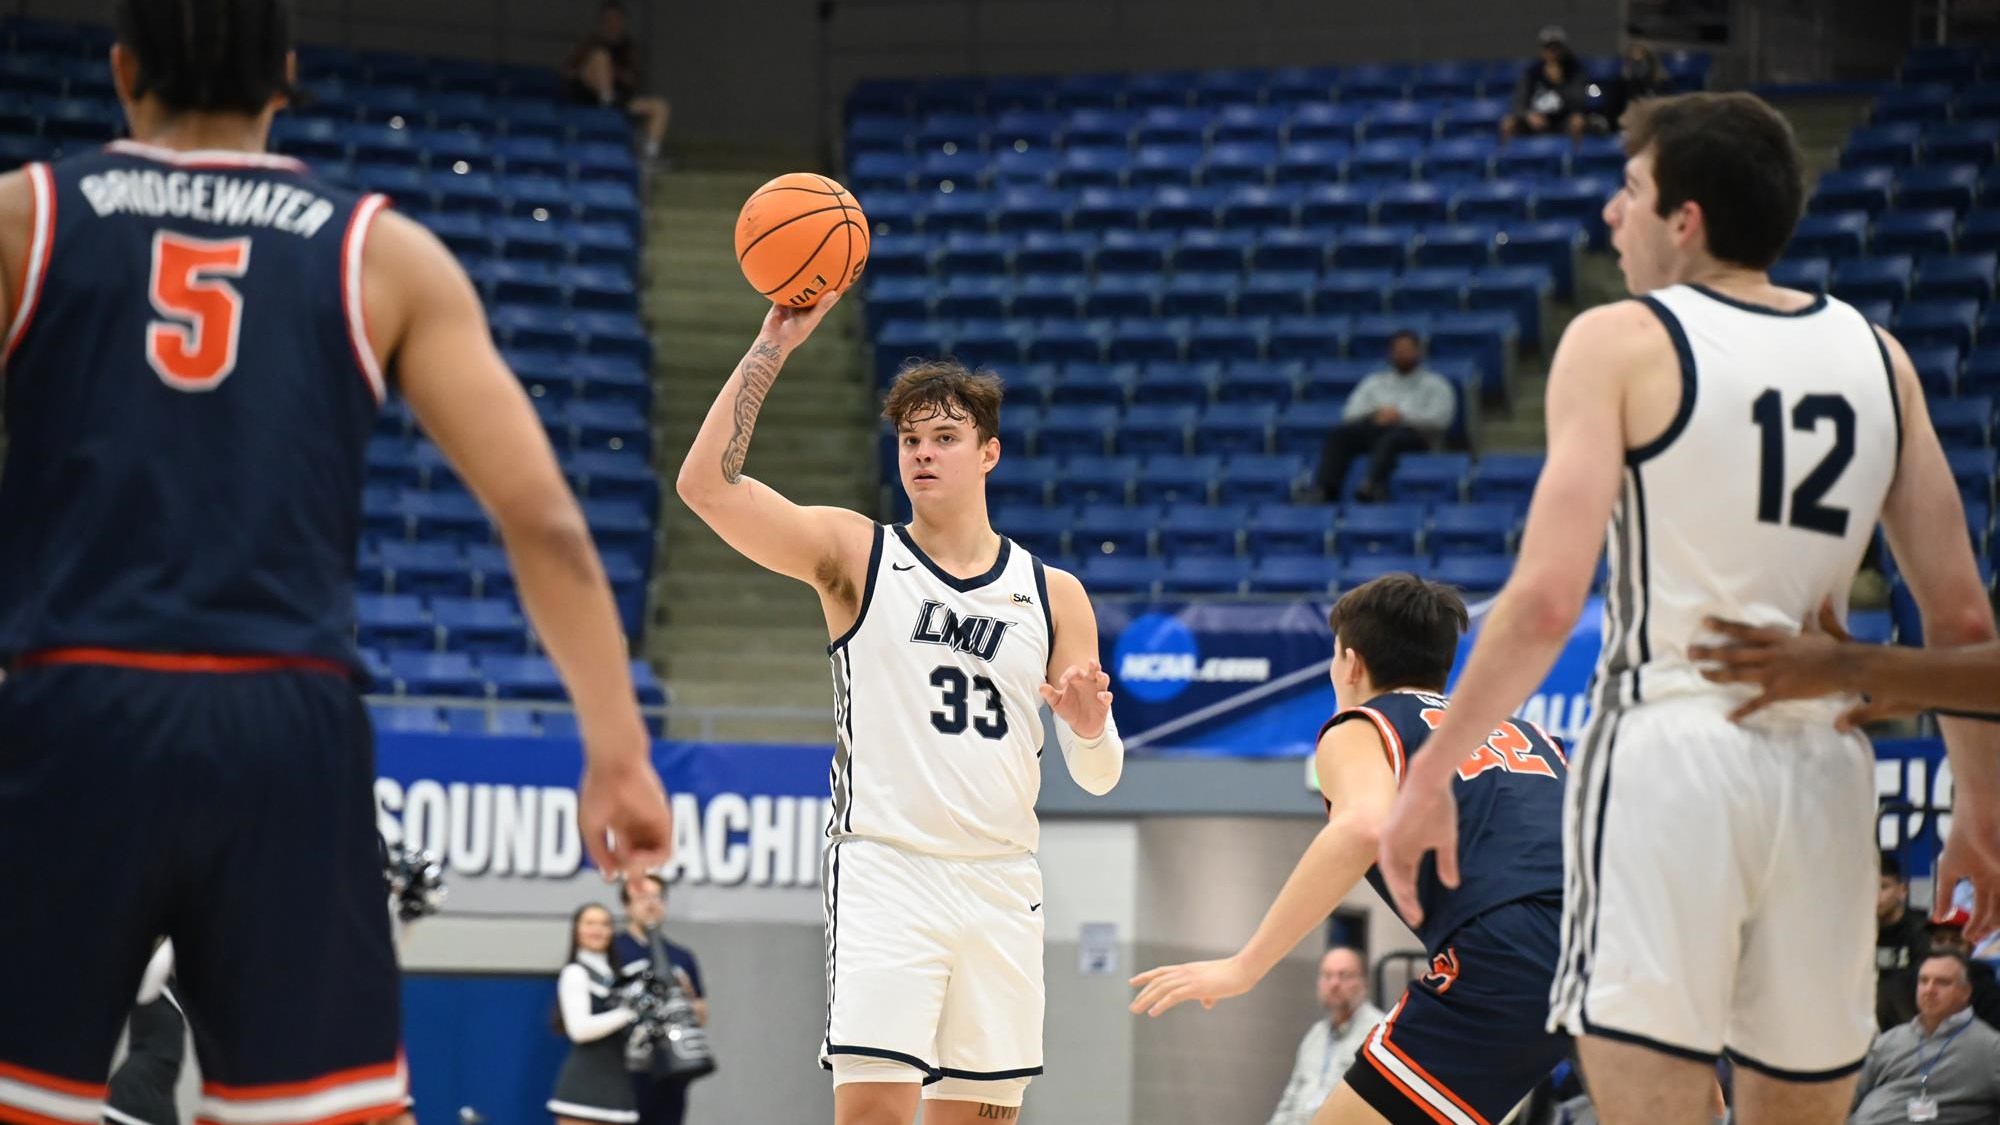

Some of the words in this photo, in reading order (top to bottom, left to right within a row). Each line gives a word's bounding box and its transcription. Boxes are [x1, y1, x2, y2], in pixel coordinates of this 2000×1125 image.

[79, 168, 334, 238] BRIDGEWATER
[146, 229, 251, 392] 5
[1752, 387, 1856, 538] 12
[910, 599, 1018, 663] LMU
[929, 665, 1008, 740] 33
[373, 777, 580, 877] SOUND
[606, 790, 834, 887] ACHI
